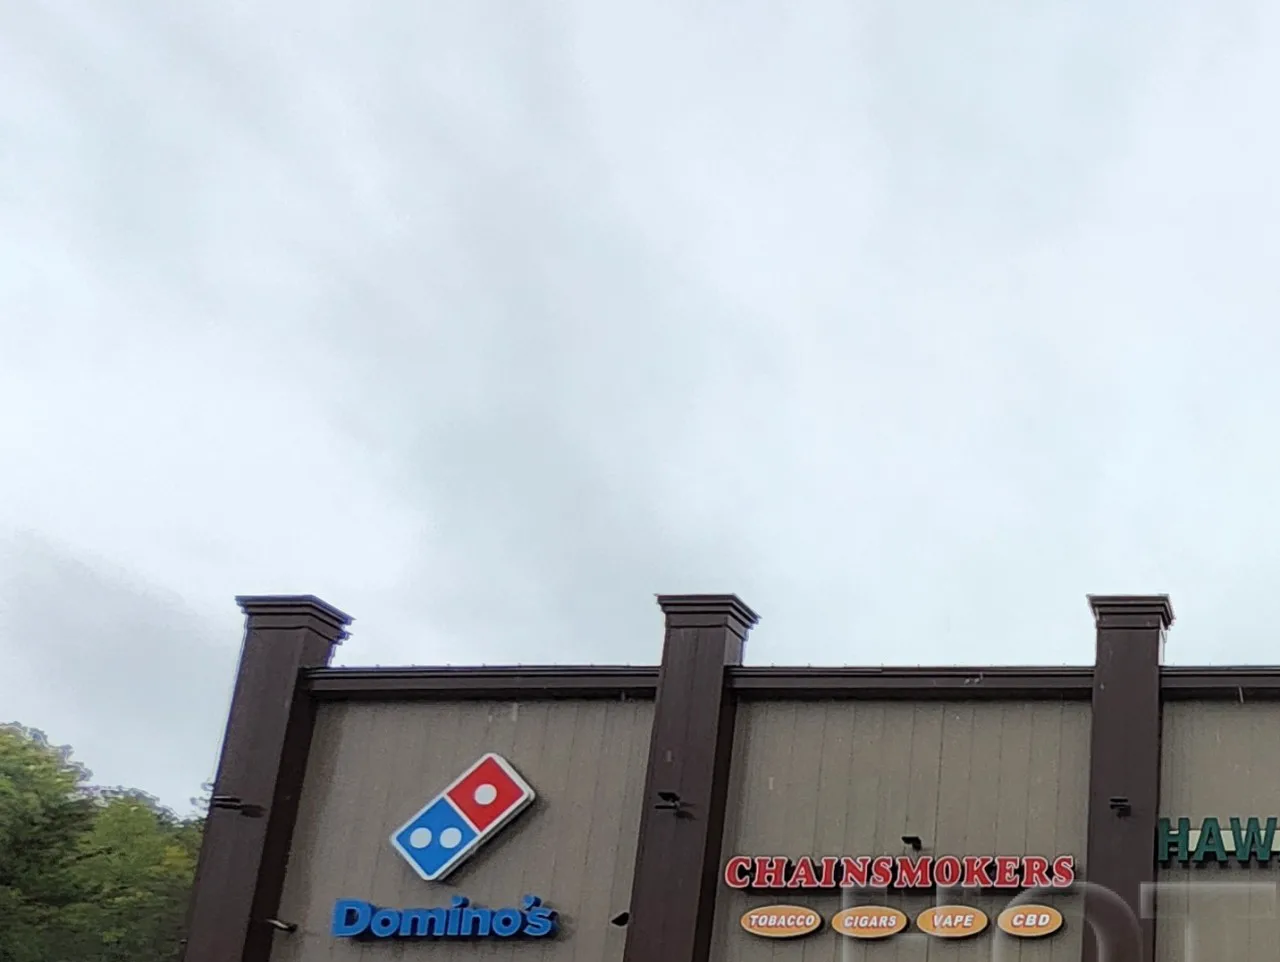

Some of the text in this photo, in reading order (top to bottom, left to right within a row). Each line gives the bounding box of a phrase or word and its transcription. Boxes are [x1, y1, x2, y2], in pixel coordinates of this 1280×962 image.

[724, 855, 1076, 889] CHAINSMOKERS
[331, 894, 556, 938] Domino's
[748, 913, 816, 928] TOBACCO
[842, 914, 897, 928] CIGARS
[932, 913, 975, 928] VAPE
[1010, 913, 1051, 928] CBD
